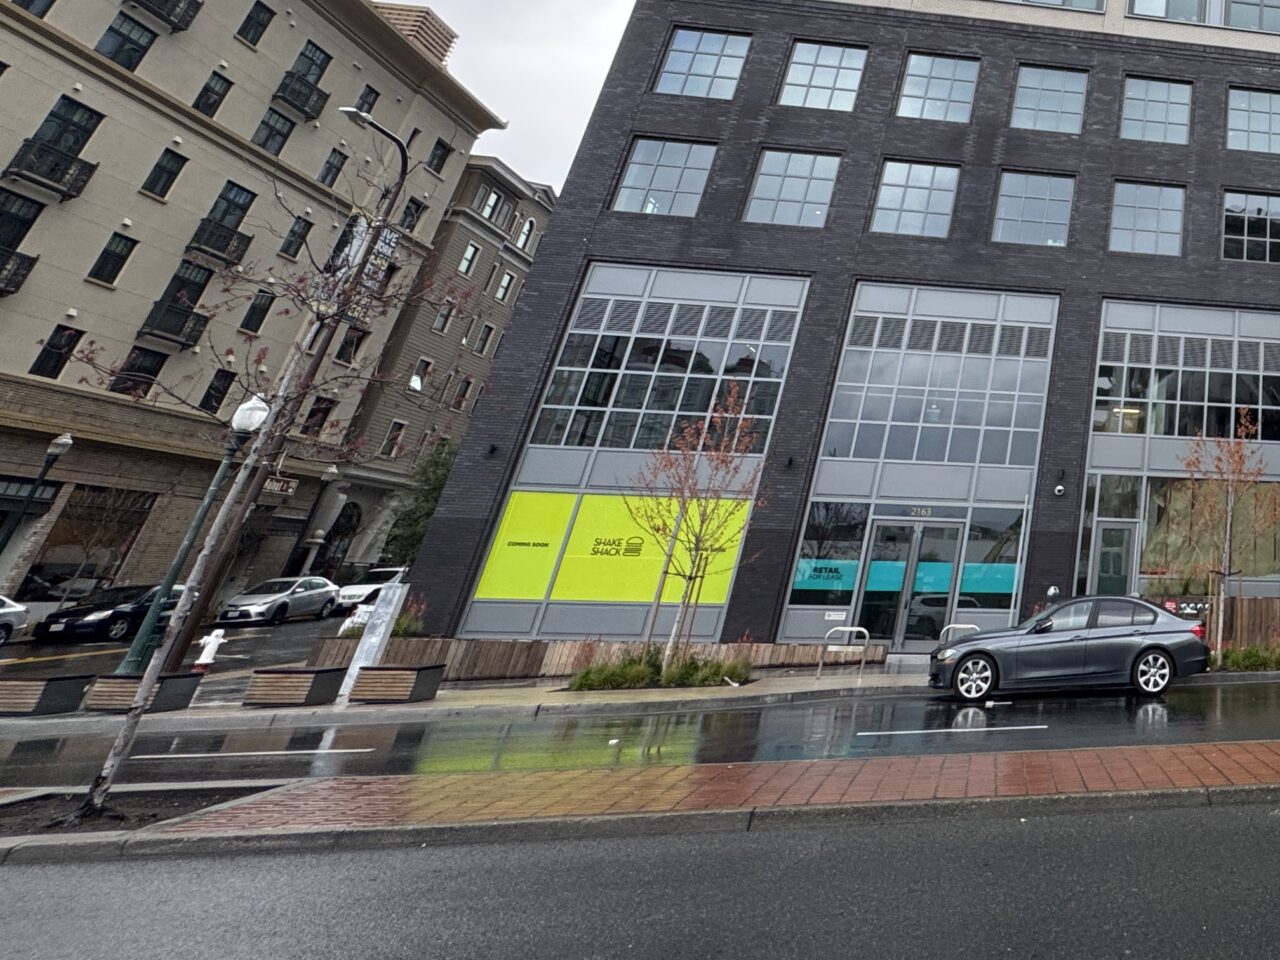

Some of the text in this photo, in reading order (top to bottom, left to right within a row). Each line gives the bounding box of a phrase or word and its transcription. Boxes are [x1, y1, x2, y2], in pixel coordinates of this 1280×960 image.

[911, 507, 931, 516] 2163
[593, 537, 623, 547] SHAKE
[590, 547, 622, 556] SHACK
